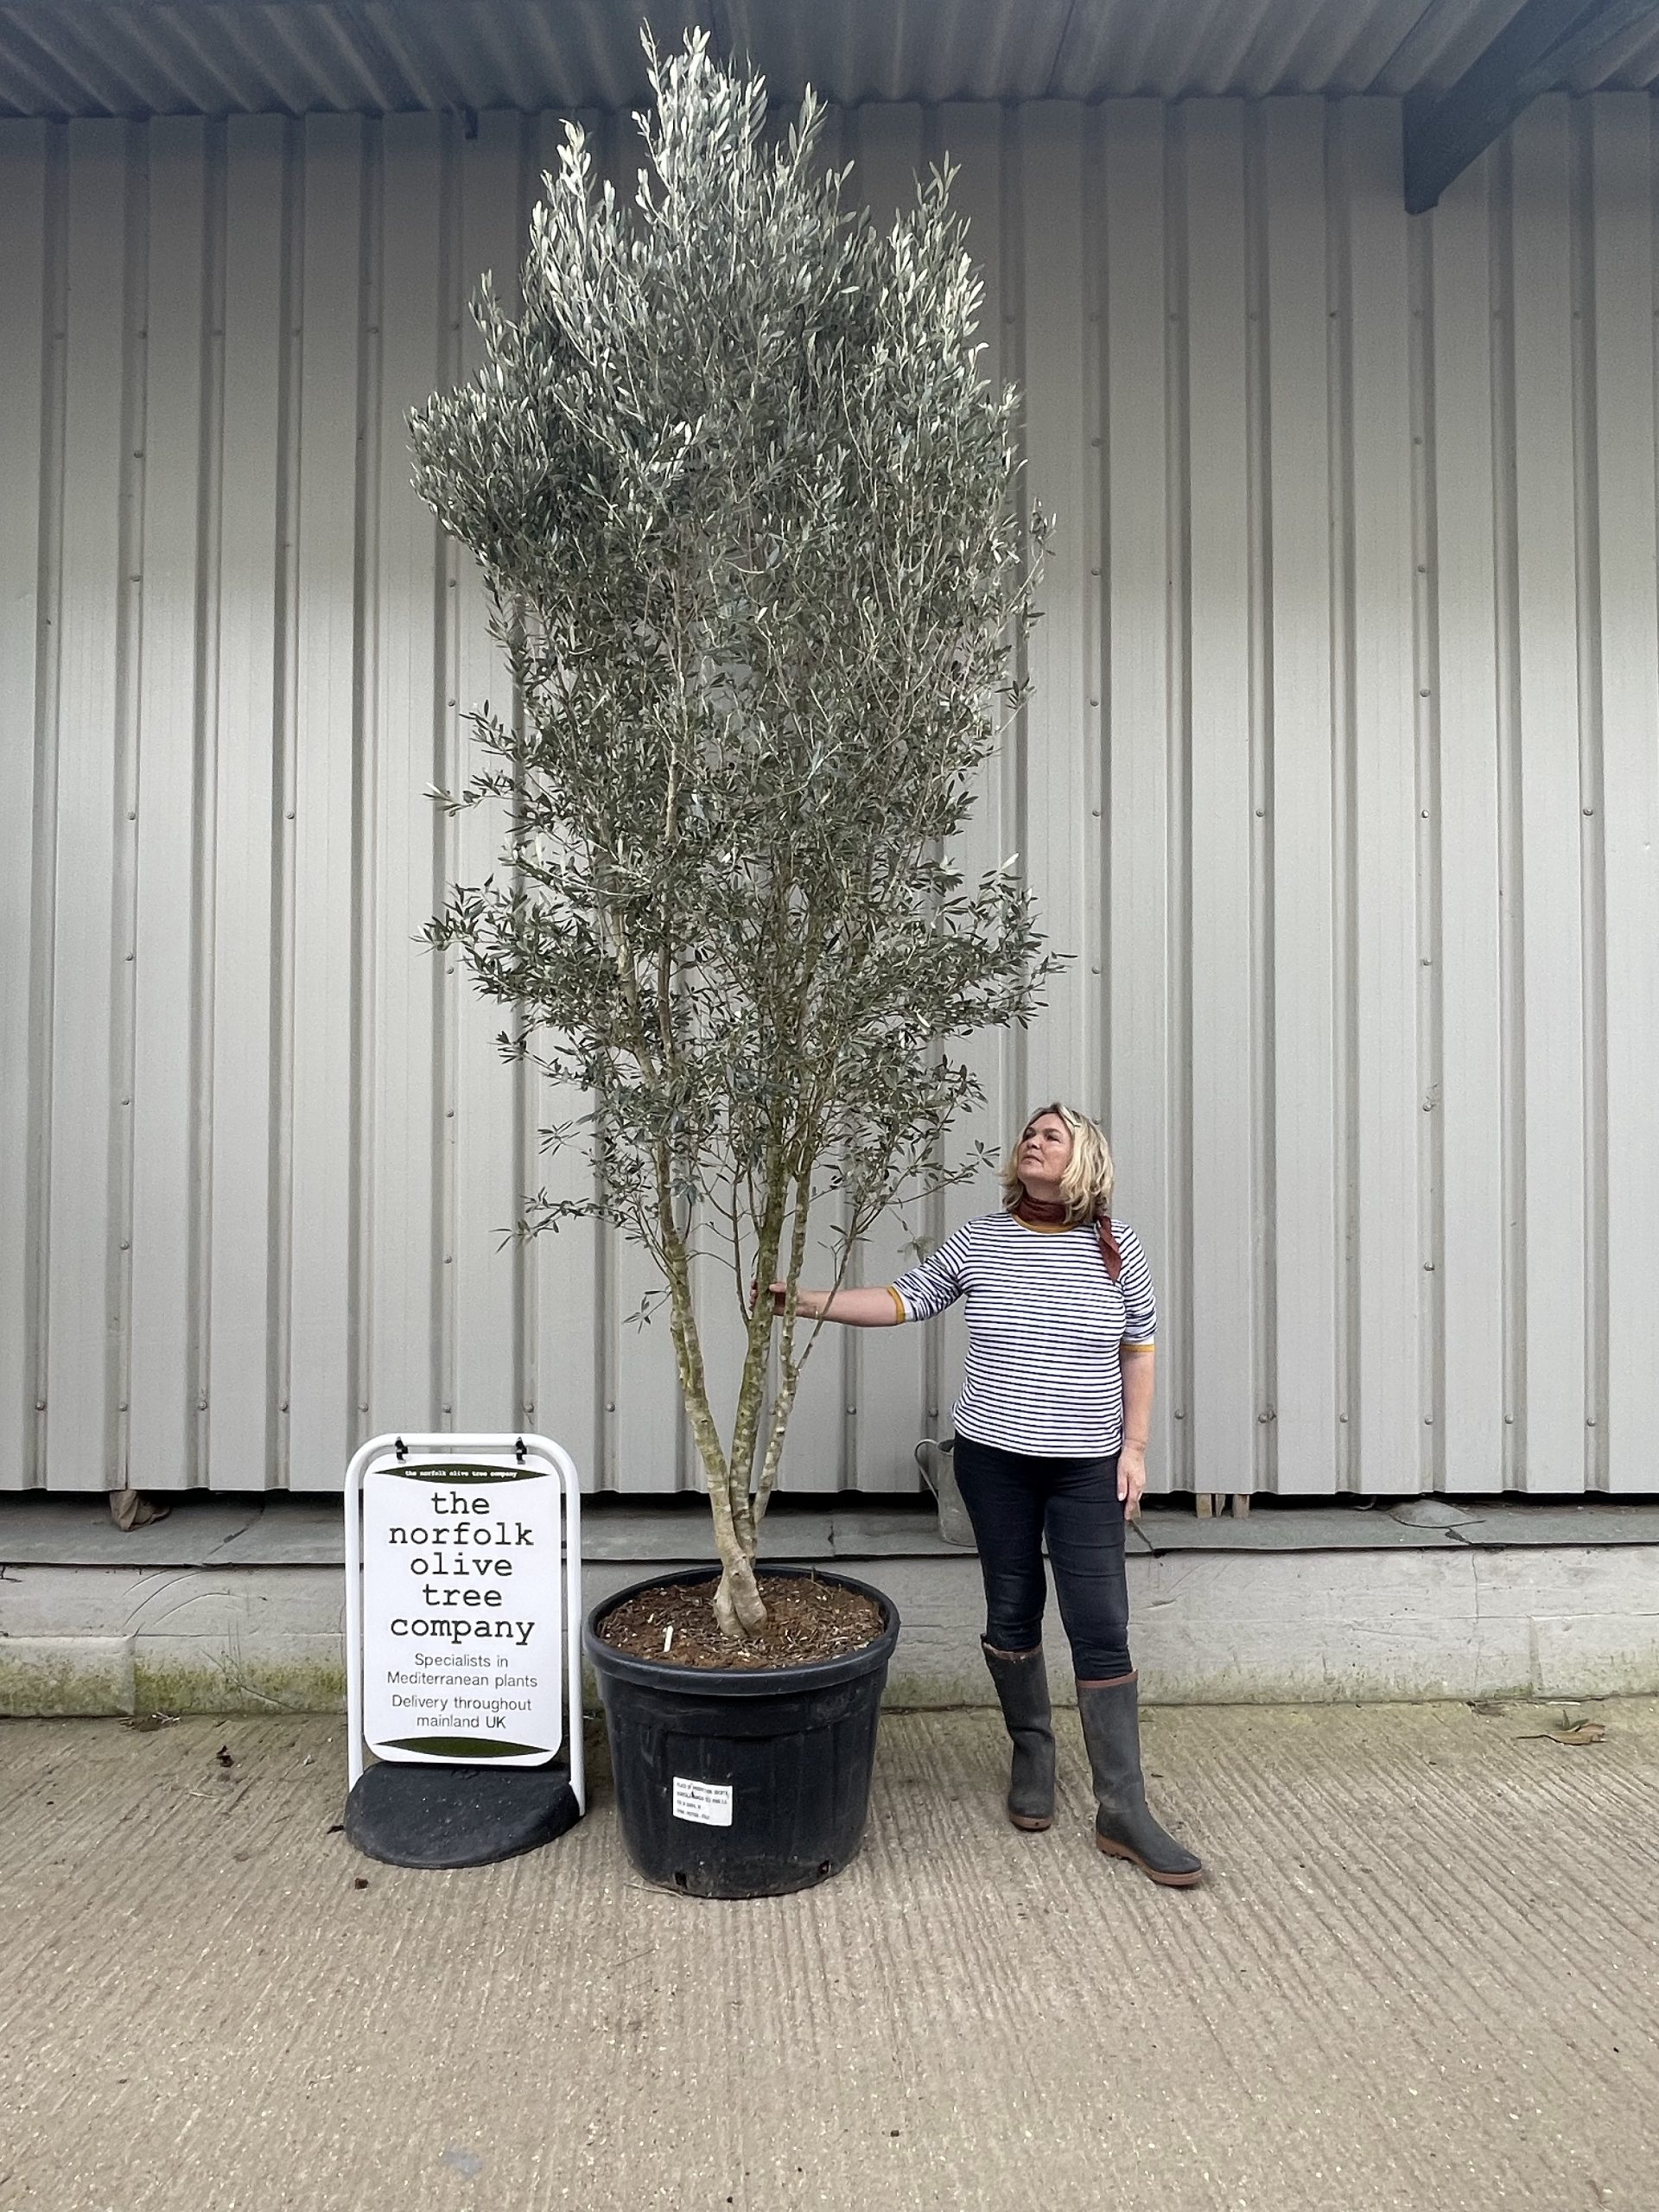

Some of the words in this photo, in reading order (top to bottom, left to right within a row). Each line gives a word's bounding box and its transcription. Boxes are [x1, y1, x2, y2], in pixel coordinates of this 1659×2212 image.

[431, 1491, 490, 1515] the
[388, 1522, 534, 1546] norfolk
[410, 1552, 512, 1576] olive
[422, 1583, 502, 1607] tree
[391, 1618, 535, 1645] company
[415, 1652, 491, 1669] Specialists
[497, 1655, 508, 1668] in
[387, 1671, 489, 1687] Mediterranean
[494, 1673, 537, 1689] plants
[391, 1694, 448, 1711] Delivery
[454, 1696, 532, 1713] throughout
[416, 1714, 480, 1728] mainland
[486, 1715, 506, 1729] UK
